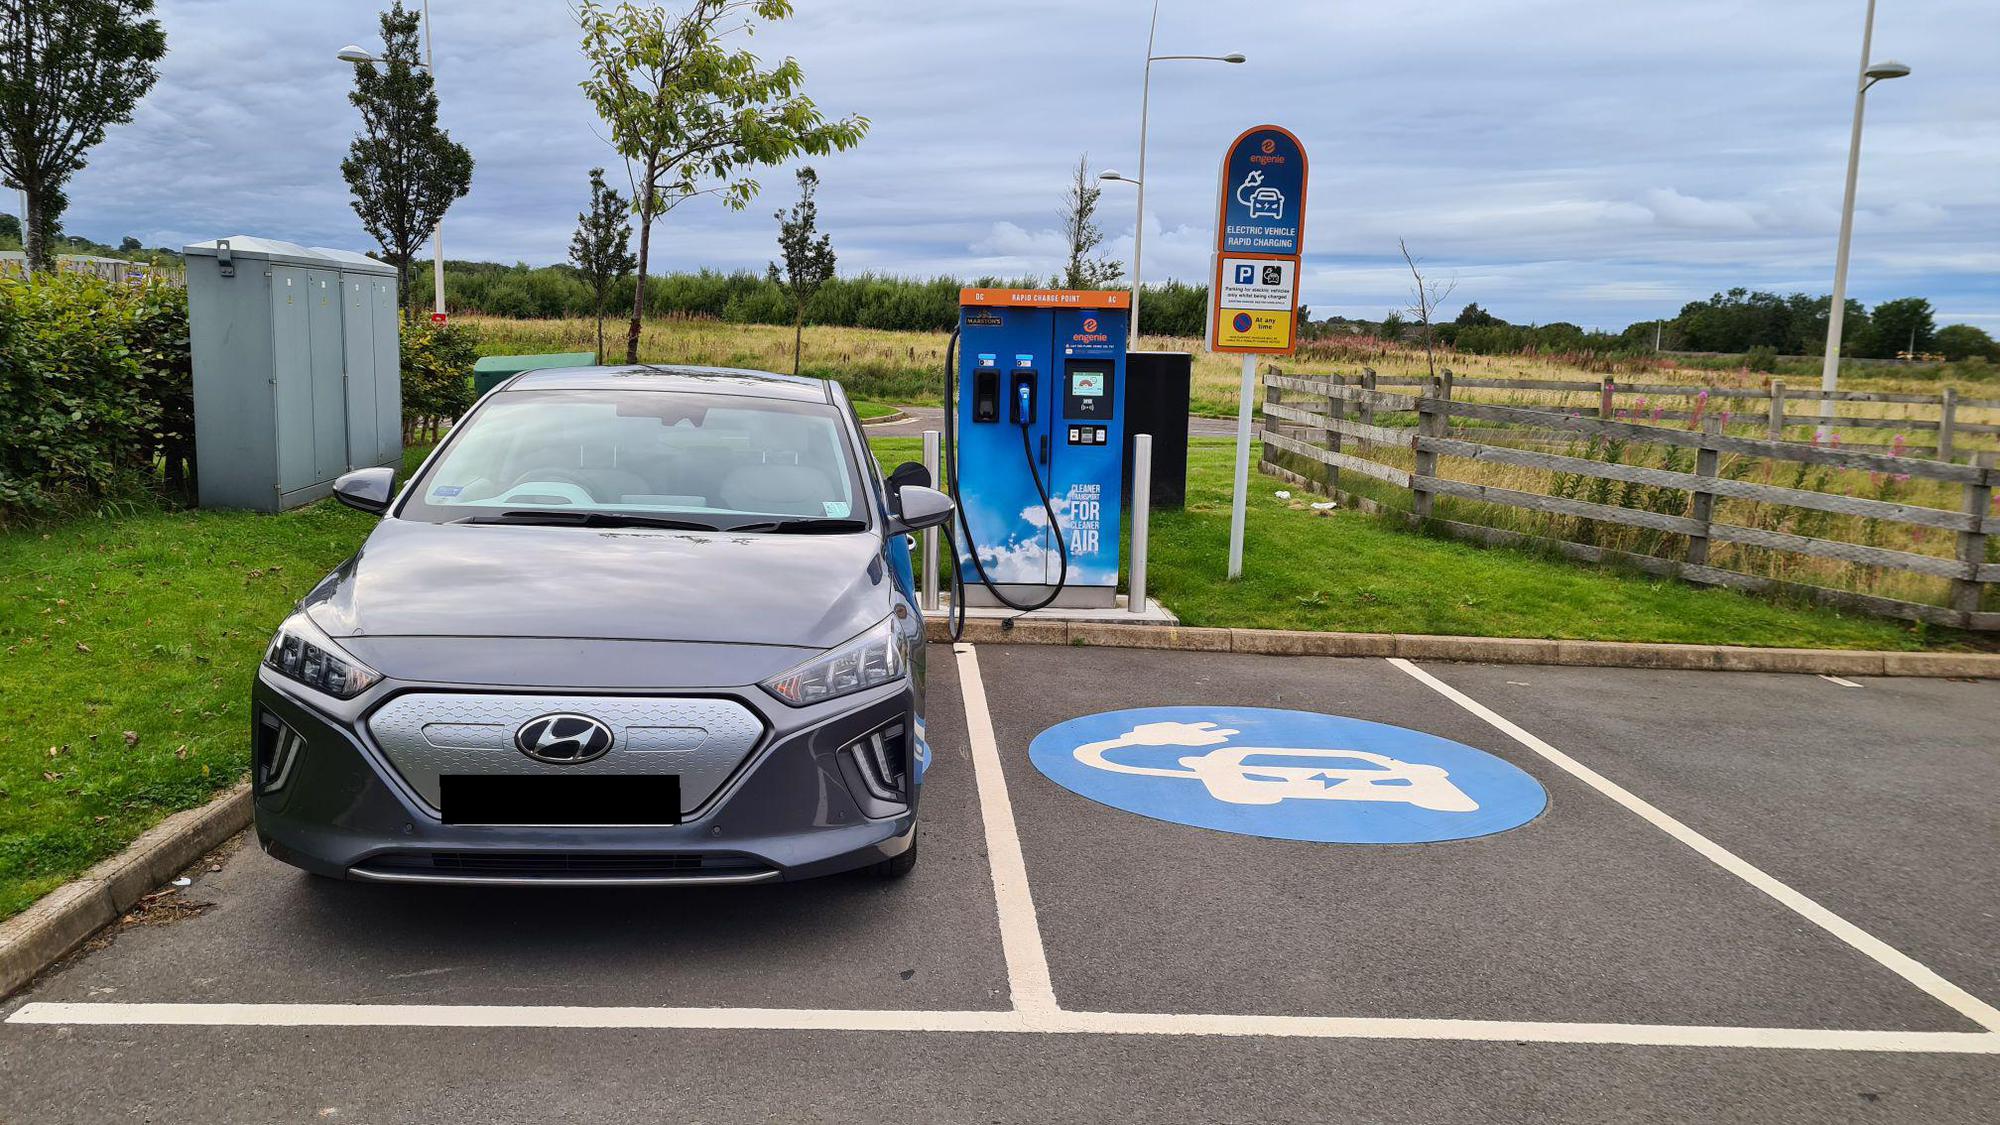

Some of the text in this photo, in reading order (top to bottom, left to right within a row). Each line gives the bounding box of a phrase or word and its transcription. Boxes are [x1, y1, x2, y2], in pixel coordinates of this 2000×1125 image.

[1250, 154, 1285, 165] engenie
[1226, 225, 1296, 236] ELECTRIC VEHICLE
[1228, 237, 1293, 248] RAPID CHARGING
[1240, 267, 1251, 282] P
[1012, 294, 1080, 303] RAPID CHARGE POINT
[1108, 295, 1117, 303] AC
[1073, 333, 1108, 345] engenie
[1071, 484, 1101, 493] CLEANER
[1070, 501, 1100, 521] FOR
[1071, 521, 1100, 530] CLEANER
[1070, 530, 1099, 552] AIR
